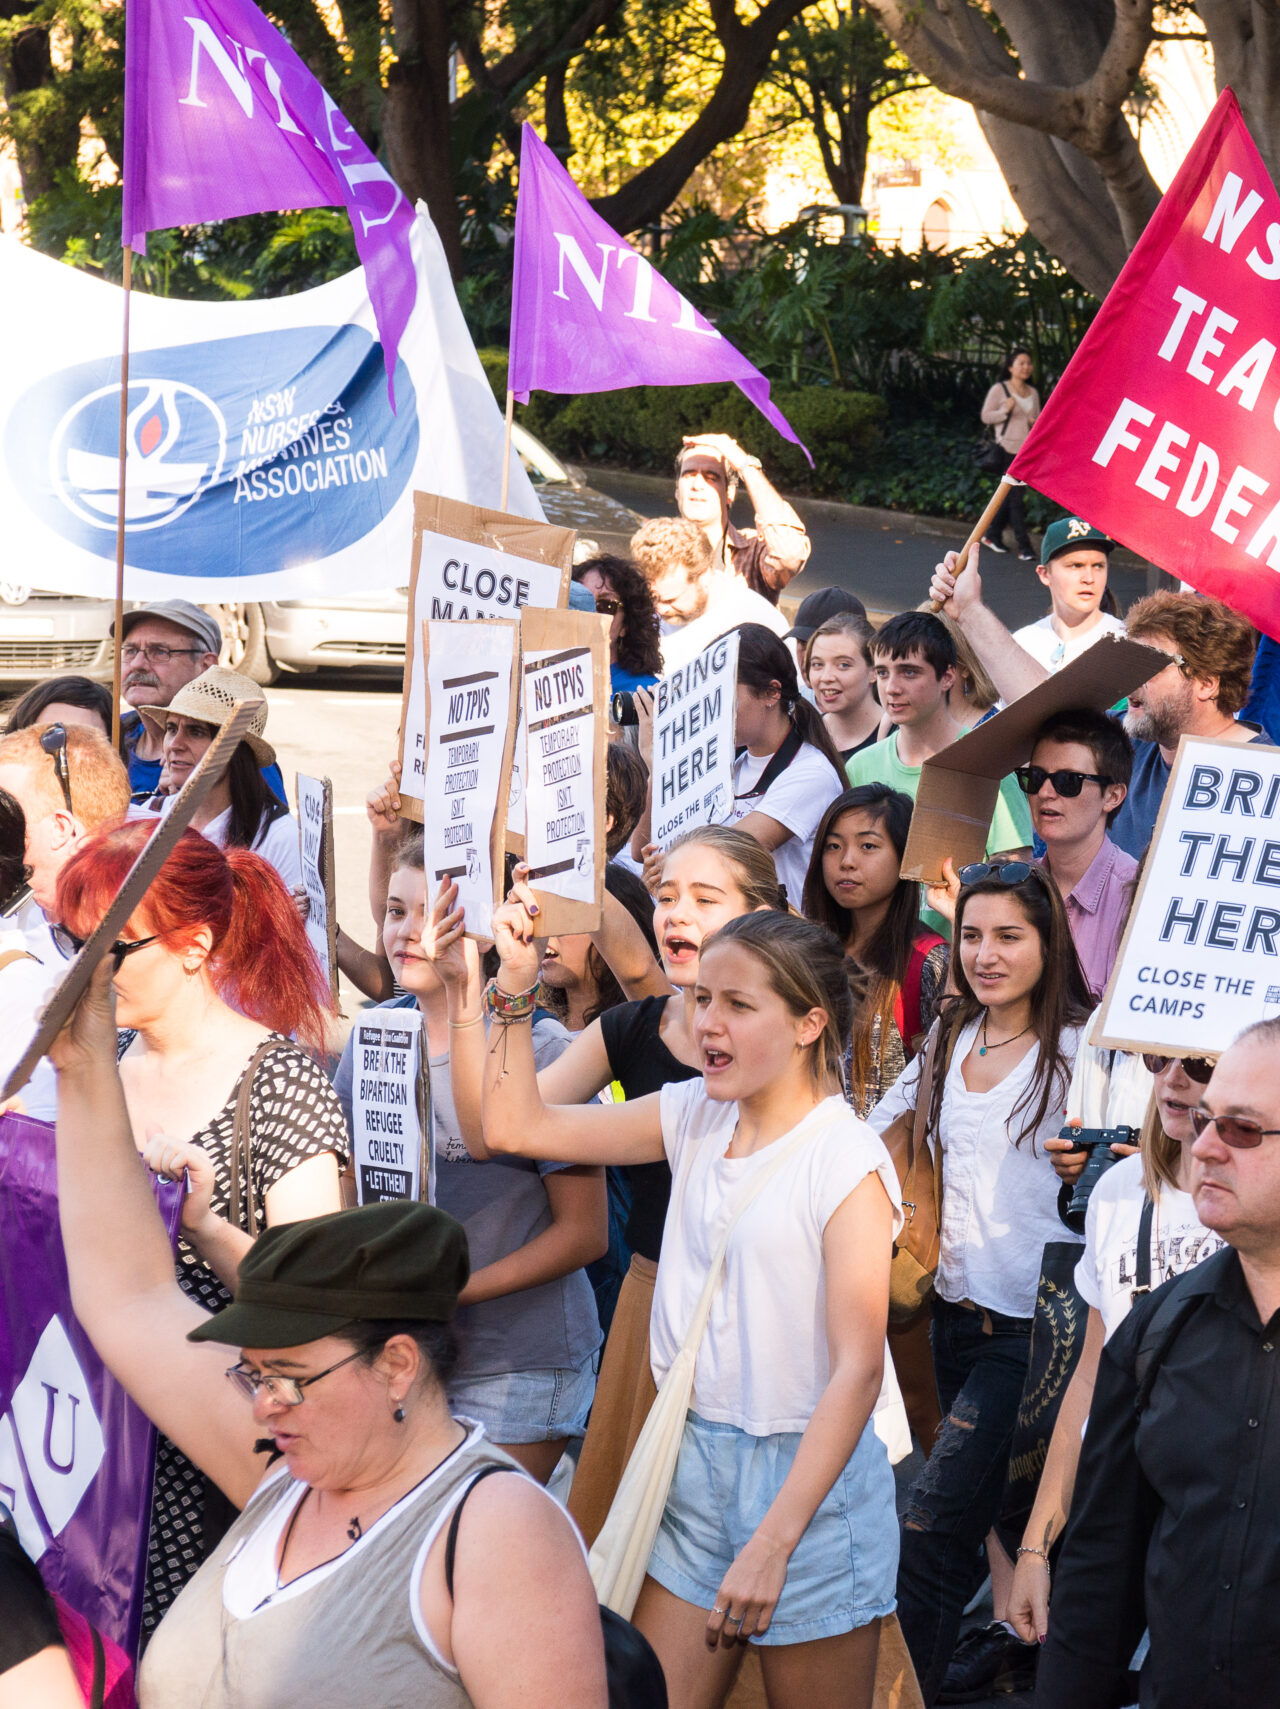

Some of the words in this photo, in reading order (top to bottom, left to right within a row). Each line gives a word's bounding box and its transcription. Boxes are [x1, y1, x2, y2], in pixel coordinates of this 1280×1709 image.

[233, 446, 388, 504] ASSOCIATION
[441, 558, 530, 609] CLOSE
[534, 675, 551, 712] NO
[553, 664, 584, 705] TPVS
[657, 638, 728, 718] BRING
[448, 692, 463, 725] NO
[465, 686, 490, 722] TPVS
[659, 685, 722, 760] THEM
[448, 741, 479, 766] TEMPORARY
[539, 725, 580, 757] TEMPORARY
[444, 768, 479, 793] PROTECTION
[543, 753, 582, 784] PROTECTION
[660, 734, 719, 808] HERE
[546, 811, 586, 841] PROTECTION
[657, 812, 684, 840] CLOSE
[685, 799, 700, 820] THE
[444, 823, 473, 847] PROTECTION
[1137, 966, 1206, 991] CLOSE
[1210, 974, 1255, 997] THE
[1128, 994, 1206, 1020] CAMPS
[363, 1029, 381, 1044] Refugee
[390, 1052, 407, 1075] THE
[360, 1078, 408, 1106] BIPARTISAN
[365, 1109, 403, 1135] REFUGEE
[368, 1139, 404, 1165] CRUELTY
[370, 1170, 385, 1191] LET
[384, 1171, 406, 1194] THEM
